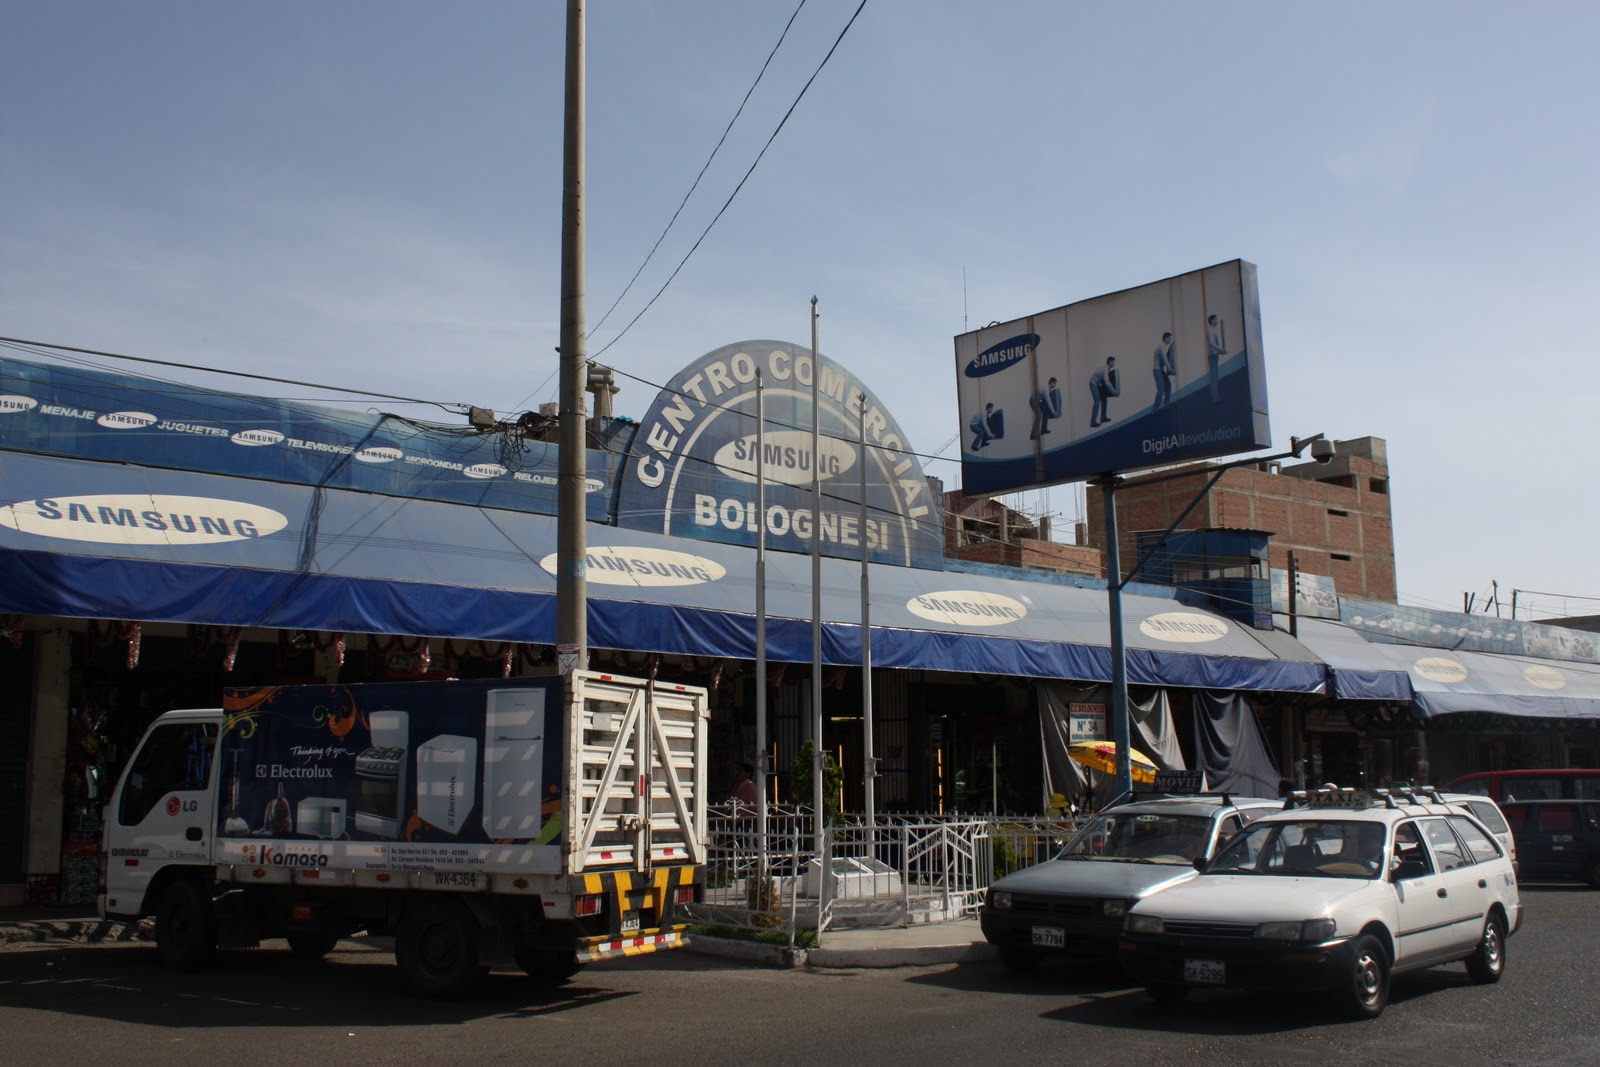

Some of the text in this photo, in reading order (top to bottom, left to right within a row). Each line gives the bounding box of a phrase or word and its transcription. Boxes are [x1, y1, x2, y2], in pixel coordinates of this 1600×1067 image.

[973, 344, 1032, 369] SAMSUNG
[0, 400, 30, 411] SUNG
[40, 404, 96, 420] MENAJE
[105, 413, 151, 426] SAMSUNG
[157, 421, 229, 437] JUGUETES
[238, 432, 279, 443] SAMSUNG
[287, 438, 356, 455] TELEVISORES
[361, 450, 398, 460] SAMSUNG
[404, 455, 464, 471] MICROONDAS
[513, 472, 558, 485] RELOJES
[636, 350, 929, 531] CENTRO COMERCIAL
[734, 438, 841, 475] SAMSUNG
[34, 499, 259, 539] SAMSUNG
[694, 494, 889, 551] BOLOGNESI
[585, 554, 713, 582] AMSUNG
[915, 596, 1020, 620] SAMSUNG
[1144, 618, 1225, 636] SAMSUNG
[1088, 720, 1098, 732] 34
[290, 746, 355, 765] Thinking of you
[270, 764, 333, 778] Electrolux
[1155, 777, 1200, 788] MOVIL
[183, 801, 198, 812] LG
[448, 776, 456, 817] Electrolux
[1314, 793, 1353, 803] TAXI
[175, 850, 206, 859] Electrolux
[259, 845, 329, 867] Kamasa
[1033, 933, 1063, 945] SK-7794
[1186, 968, 1224, 981] SK-5295
